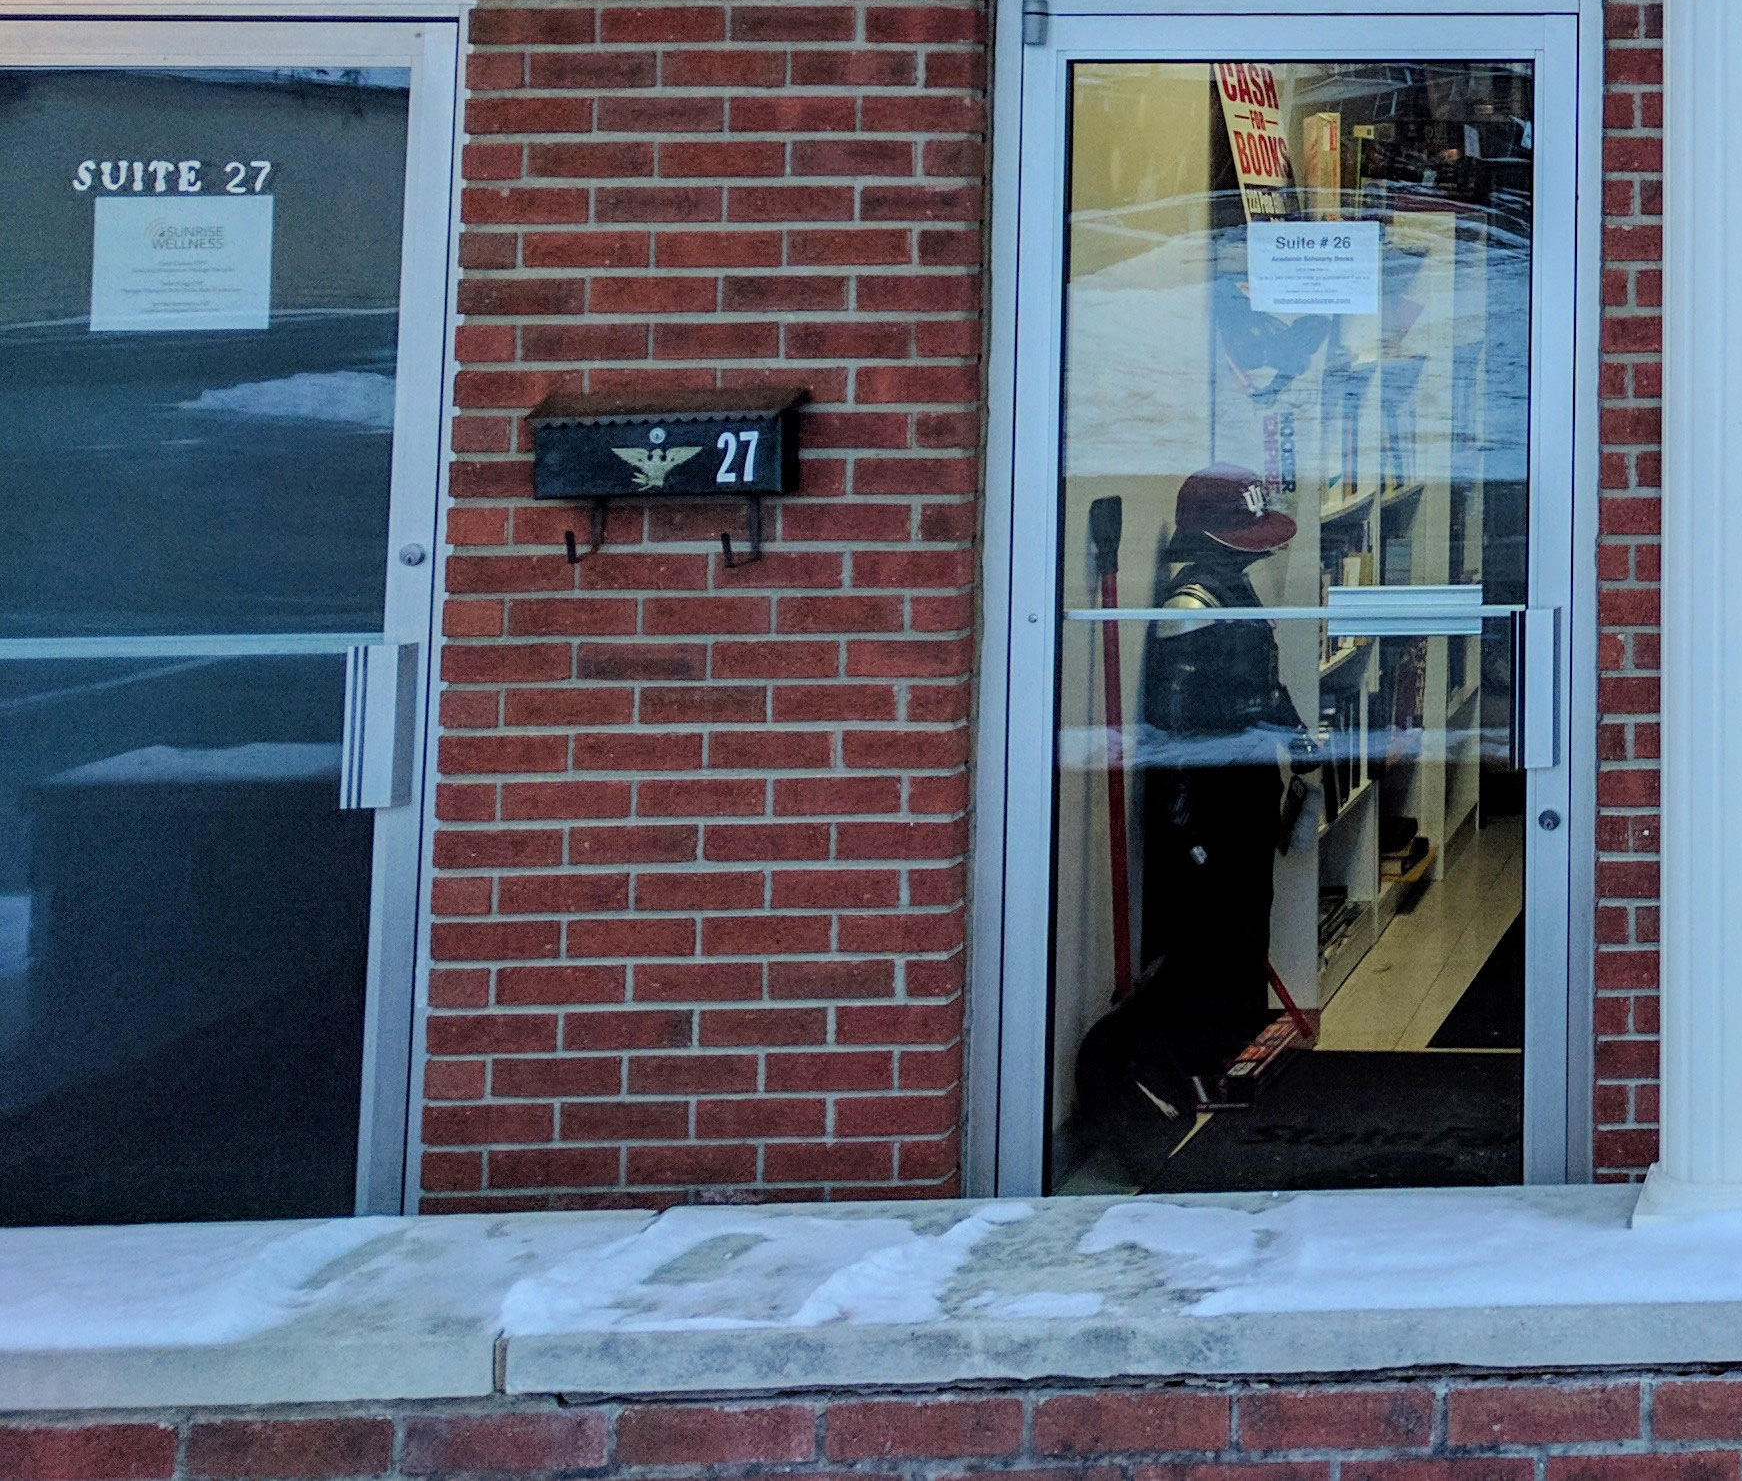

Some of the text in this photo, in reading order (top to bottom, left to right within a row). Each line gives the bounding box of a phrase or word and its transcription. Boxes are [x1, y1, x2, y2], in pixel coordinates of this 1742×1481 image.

[1218, 63, 1280, 110] CASH
[1233, 130, 1294, 180] BOOKS
[72, 160, 272, 193] SUITE 27
[152, 238, 225, 250] WELLNESS
[166, 226, 224, 238] SUNRISE
[1275, 236, 1351, 249] Suite # 26
[716, 430, 759, 483] 27
